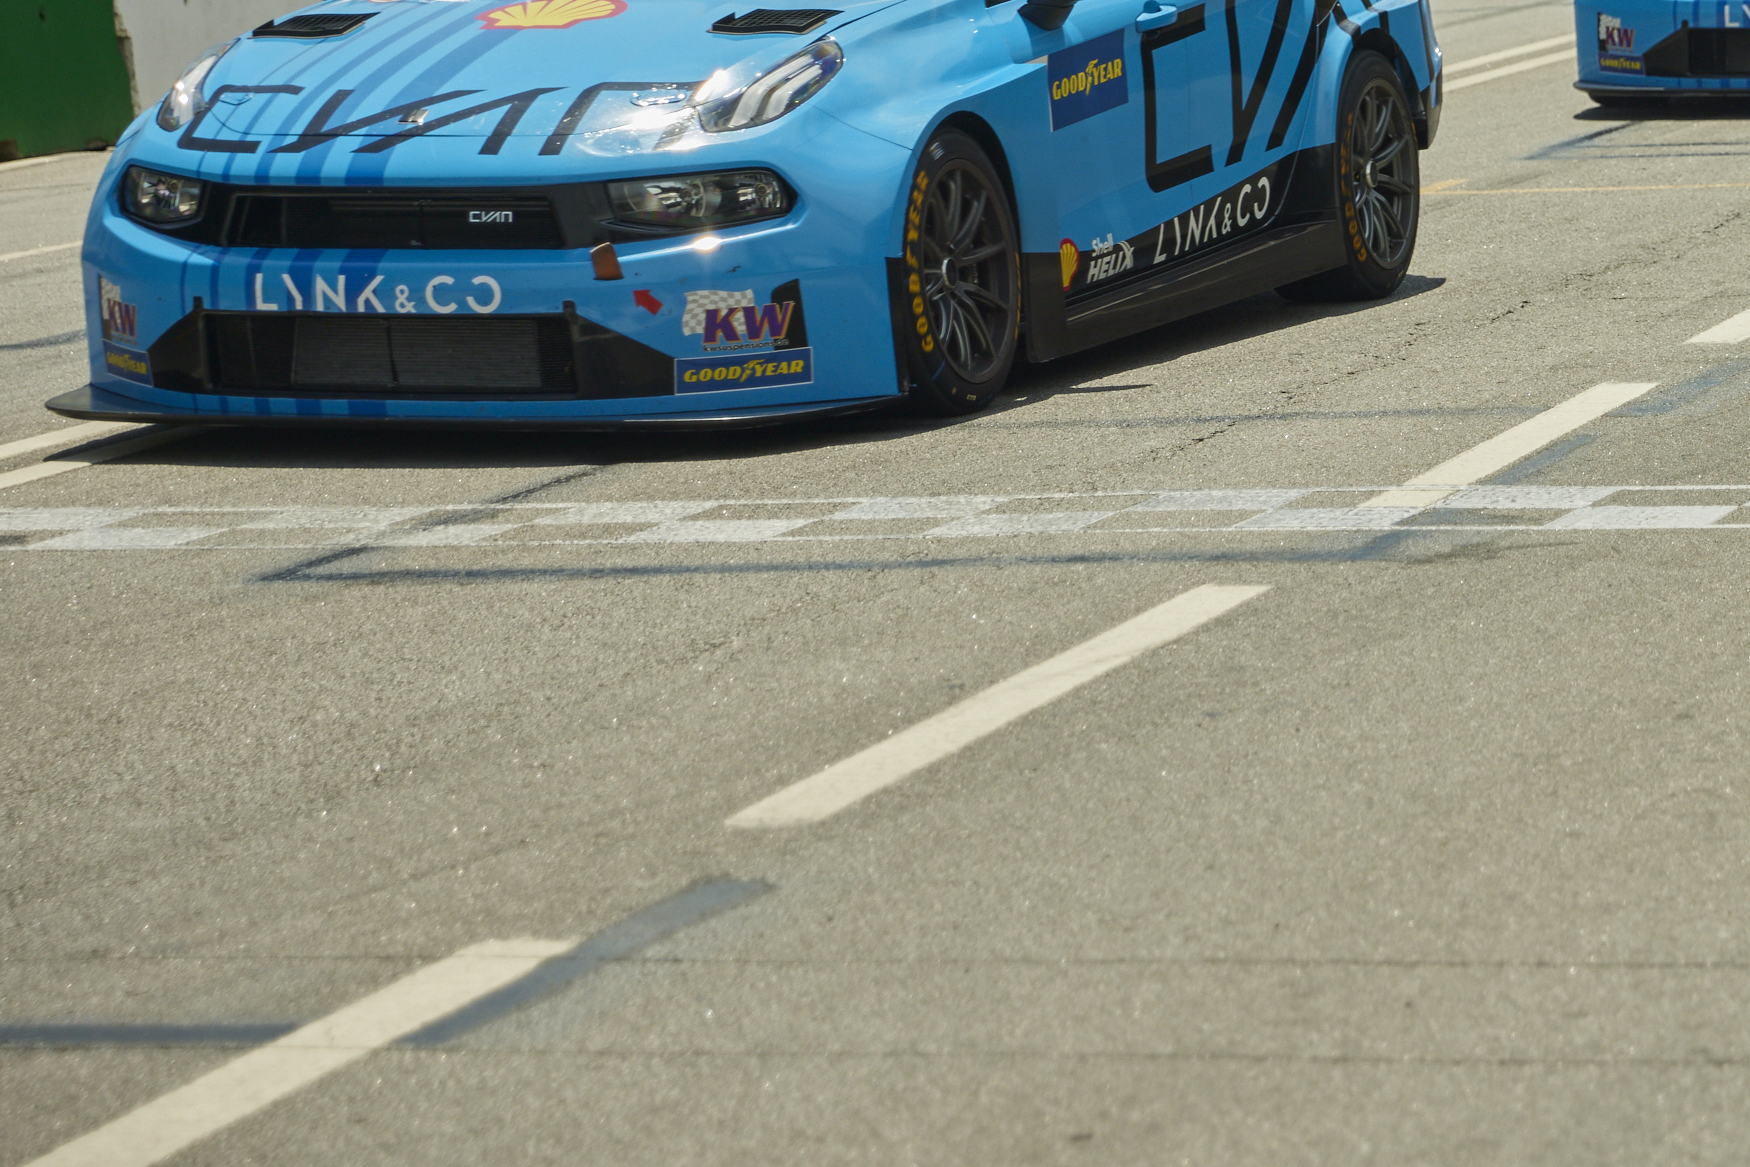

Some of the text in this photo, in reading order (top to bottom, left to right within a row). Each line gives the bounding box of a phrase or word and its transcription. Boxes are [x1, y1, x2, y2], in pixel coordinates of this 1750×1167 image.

[1604, 26, 1635, 50] KW
[1087, 240, 1135, 284] HELIX
[1092, 233, 1114, 257] Shell
[107, 298, 137, 339] KW
[703, 301, 795, 344] KW
